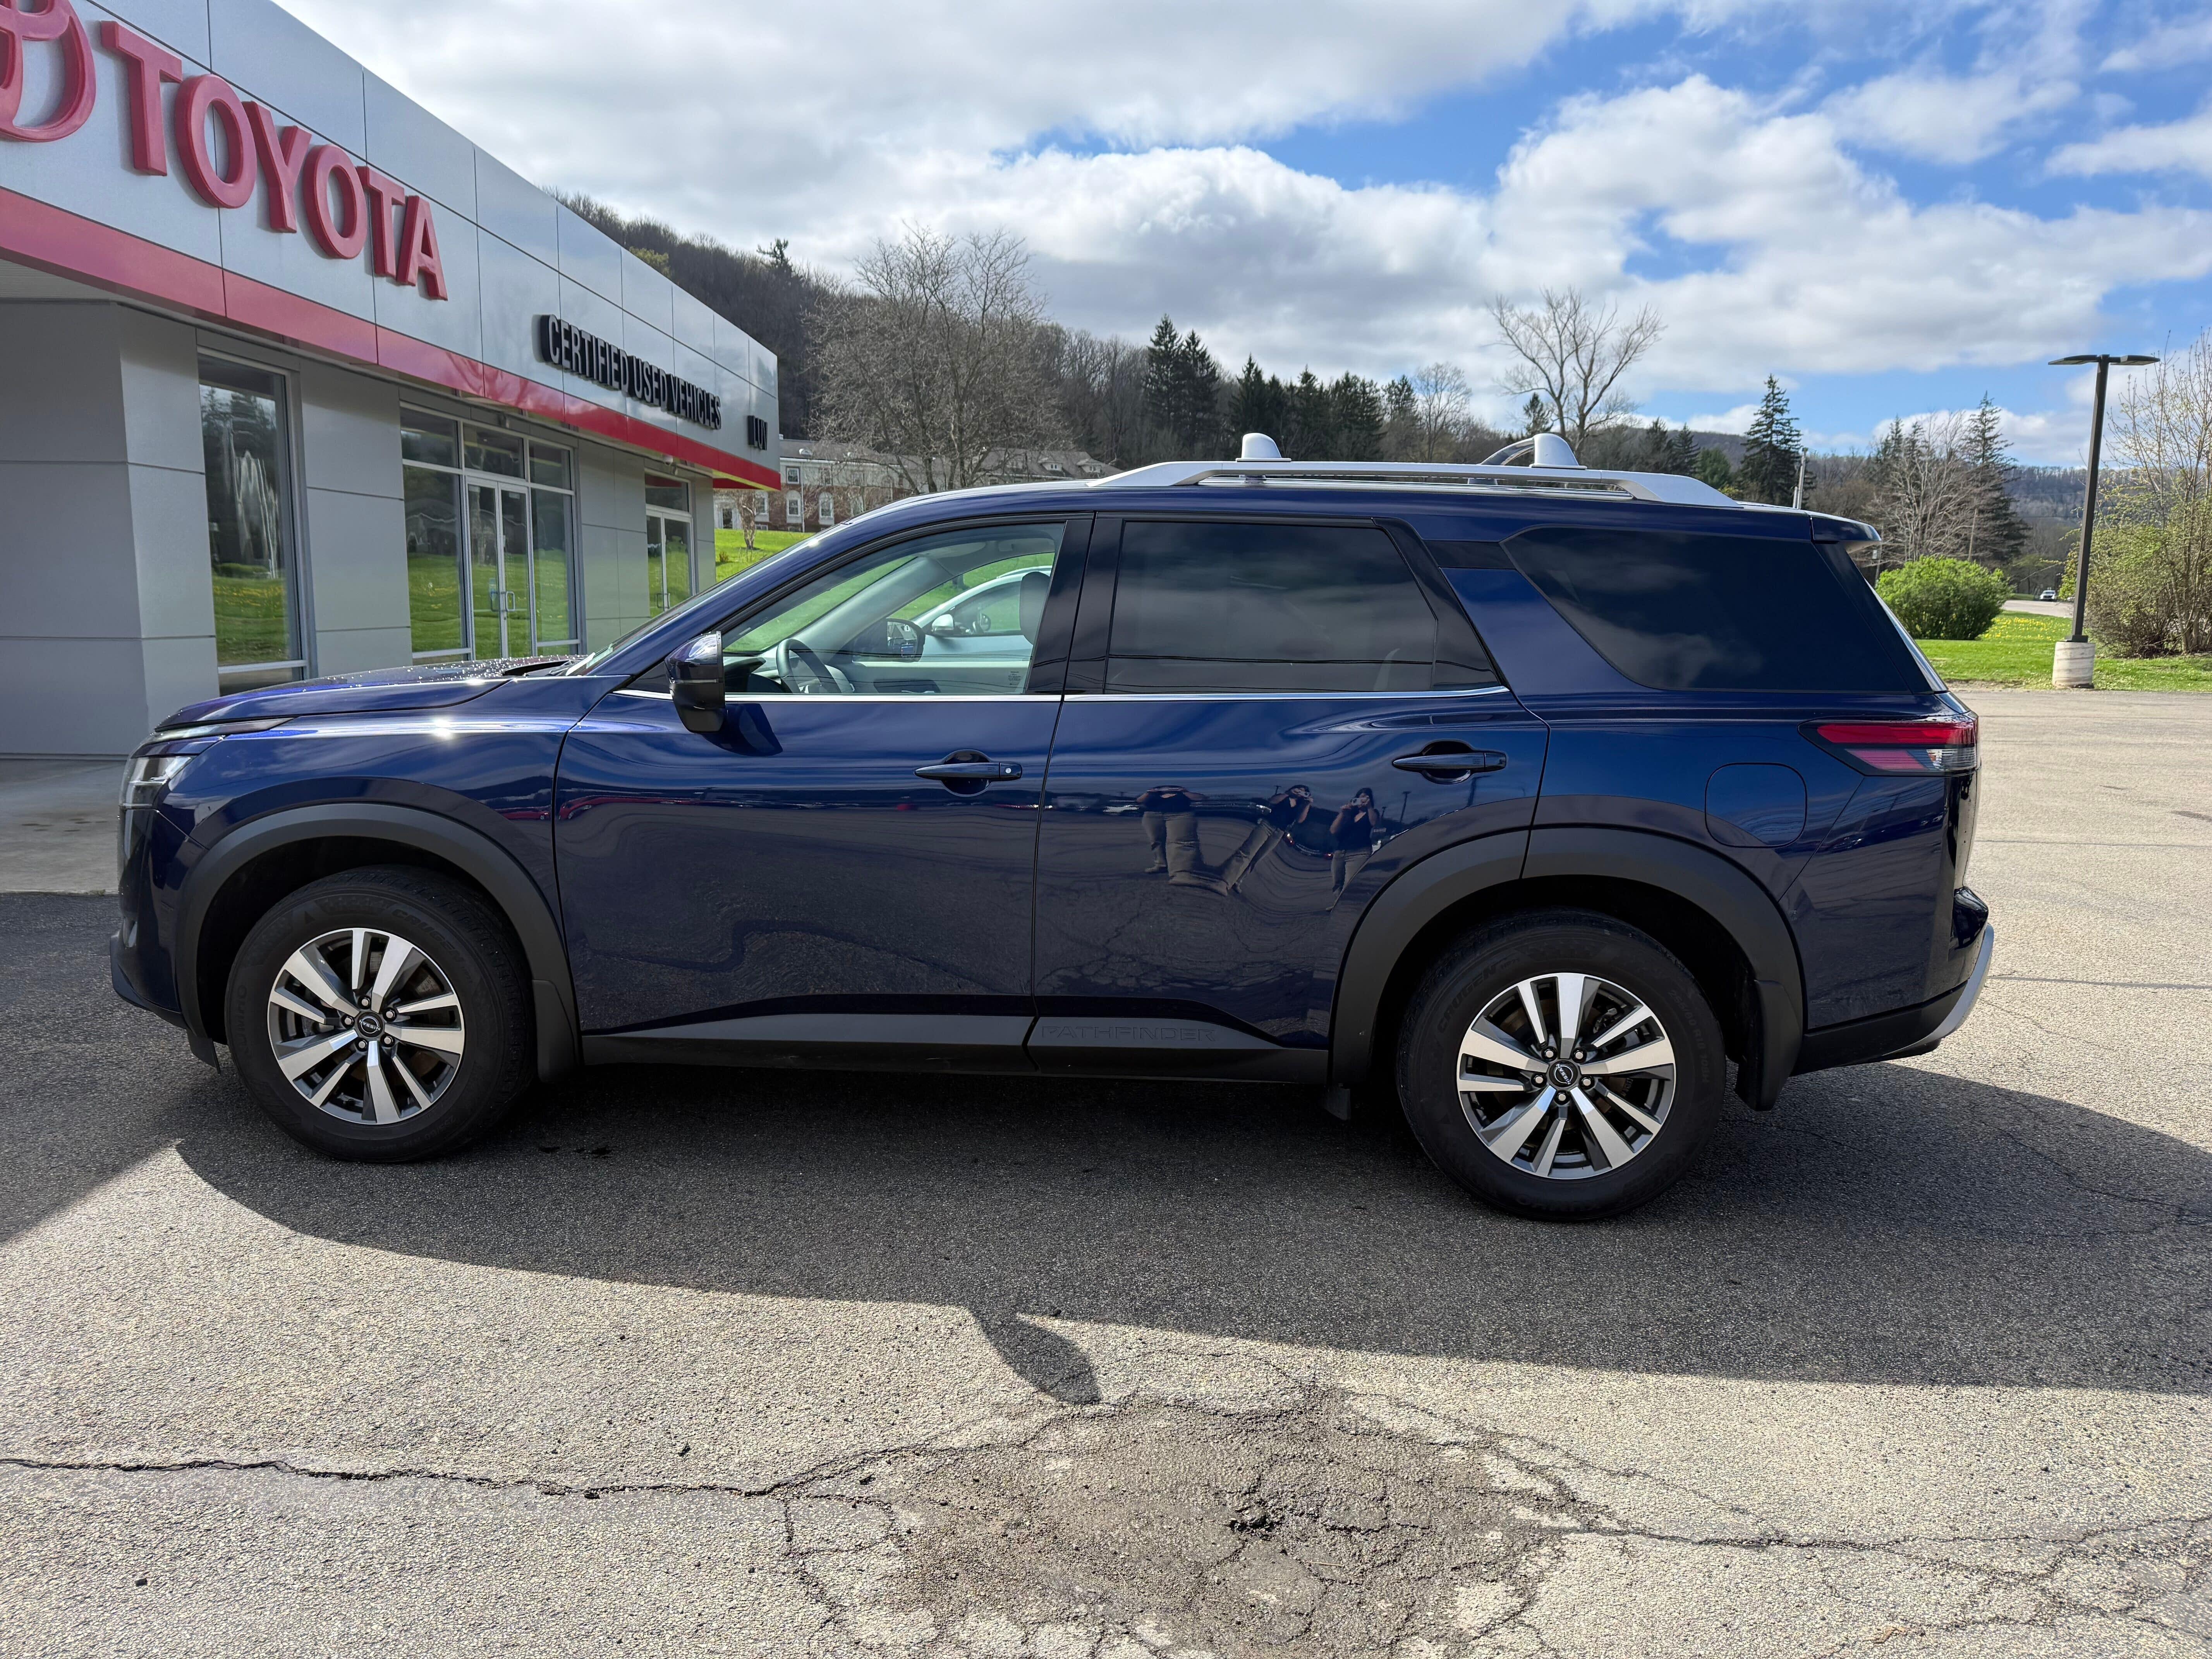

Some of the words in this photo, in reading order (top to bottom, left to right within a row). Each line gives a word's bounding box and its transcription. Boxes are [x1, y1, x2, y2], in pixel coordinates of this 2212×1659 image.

[101, 20, 448, 301] TOYOTA
[545, 314, 629, 393] CERTIFIED
[631, 355, 668, 411] USED
[669, 373, 722, 430] VEHICLES
[1041, 1026, 1217, 1042] PATHFINDER
